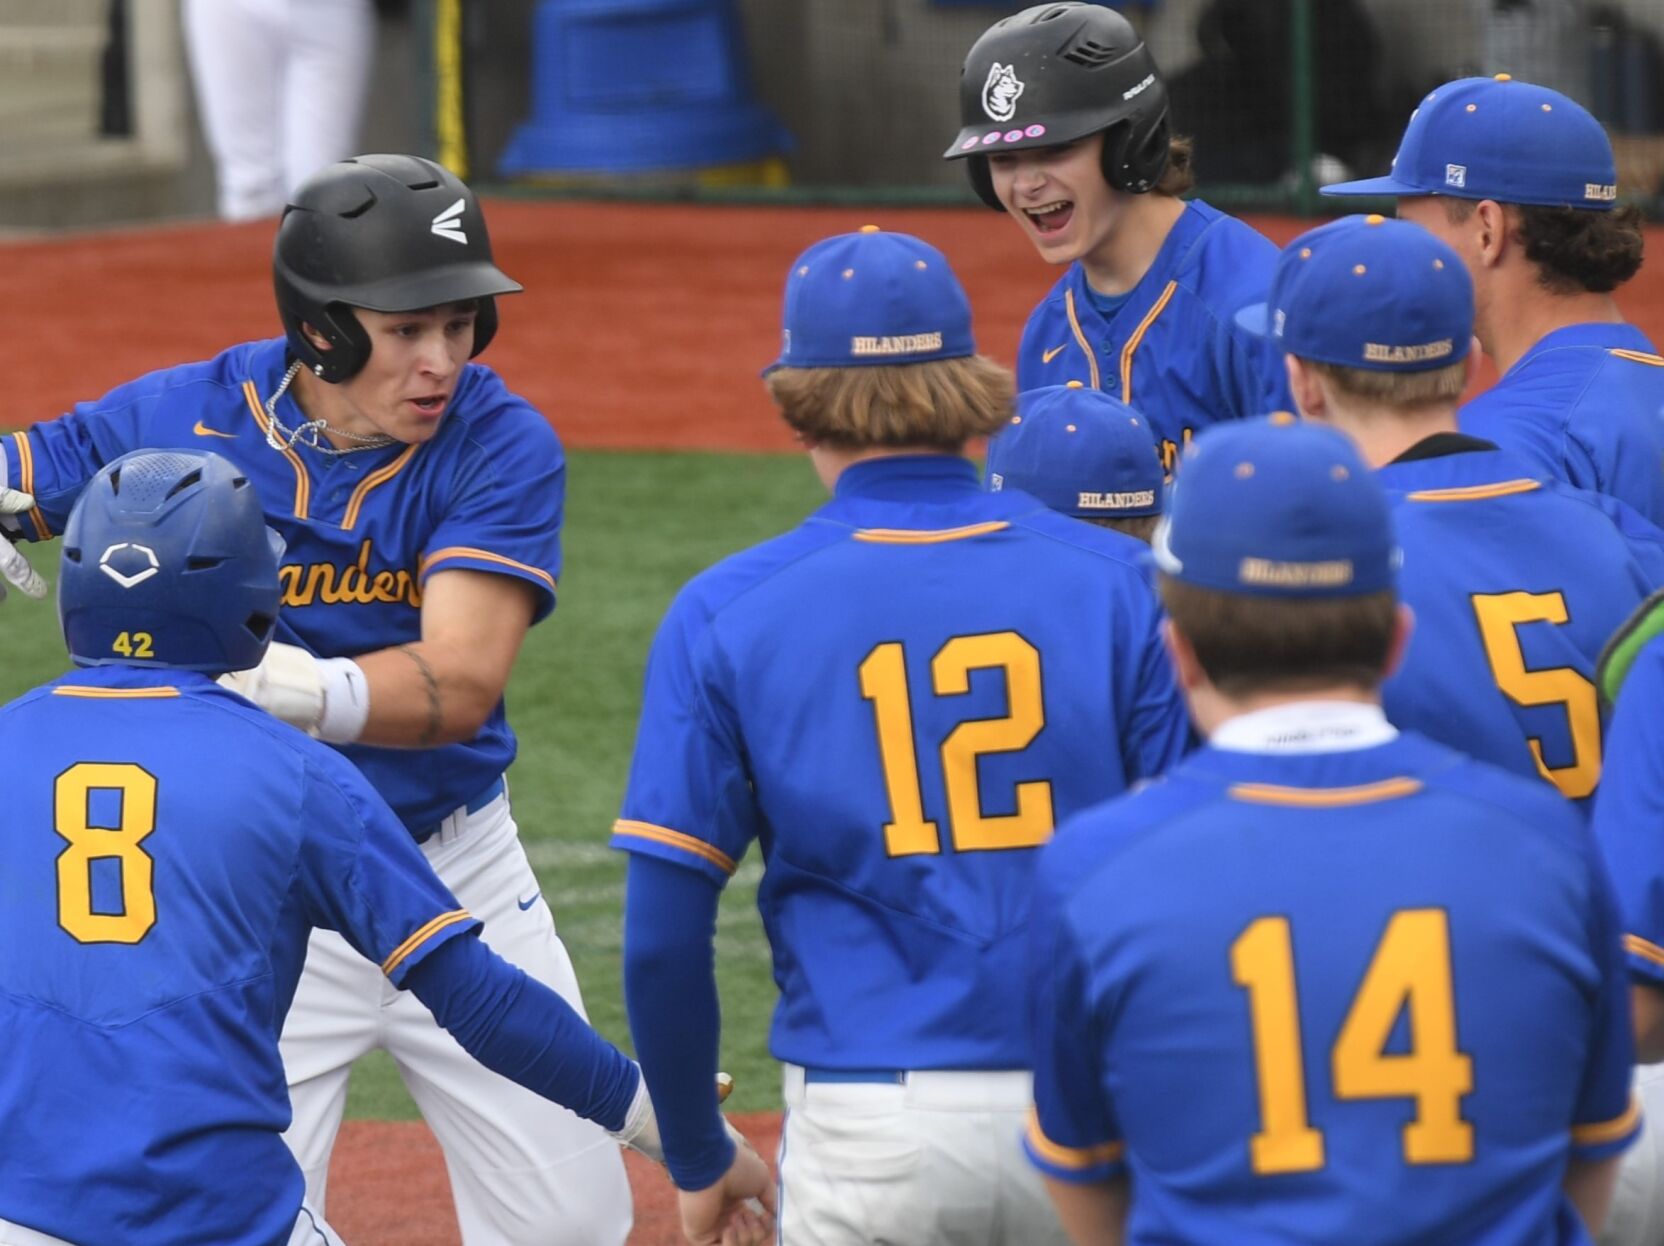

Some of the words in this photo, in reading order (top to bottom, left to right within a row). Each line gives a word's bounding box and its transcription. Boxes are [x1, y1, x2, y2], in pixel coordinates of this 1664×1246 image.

[852, 332, 943, 355] HILANDERS
[1363, 339, 1453, 363] HILANDERS
[1078, 490, 1155, 508] HILANDERS
[112, 631, 154, 657] 42
[1470, 589, 1603, 798] 5
[858, 630, 1055, 857] 12
[53, 761, 158, 944] 8
[1229, 906, 1474, 1176] 14
